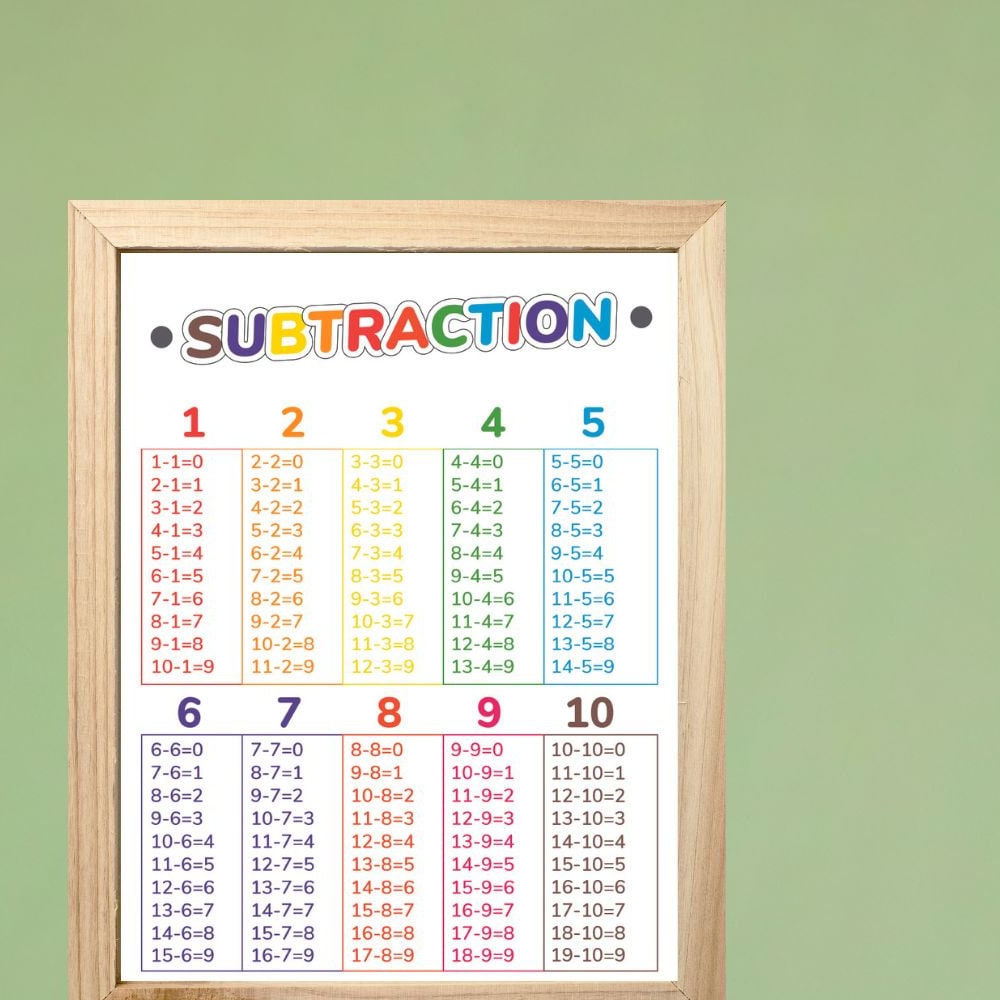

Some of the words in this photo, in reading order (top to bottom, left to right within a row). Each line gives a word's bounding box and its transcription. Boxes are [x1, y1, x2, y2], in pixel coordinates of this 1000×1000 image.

[184, 295, 614, 362] SUBTRACTION
[183, 406, 206, 438] 1
[281, 405, 306, 439] 2
[380, 405, 405, 439] 3
[480, 406, 507, 438] 4
[581, 406, 606, 439] 5
[151, 454, 204, 469] 1-1=0
[251, 453, 304, 470] 2-2=0
[351, 453, 404, 470] 3-3=0
[450, 454, 504, 469] 4-4=0
[551, 453, 604, 470] 5-5=0
[151, 477, 204, 493] 2-1=1
[251, 477, 303, 493] 3-2=1
[451, 477, 504, 493] 5-4=1
[551, 477, 604, 493] 6-5=1
[151, 522, 203, 538] 4-1=3
[251, 522, 303, 538] 5-2=3
[451, 522, 503, 538] 7-4=3
[551, 522, 603, 538] 8-5=3
[151, 545, 204, 561] 5-1=4
[250, 545, 304, 561] 6-2=4
[450, 545, 504, 561] 8-4=4
[551, 545, 604, 561] 9-5=4
[151, 591, 204, 607] 7-1=6
[250, 591, 304, 607] 8-2=6
[452, 591, 515, 607] 10-4=6
[551, 591, 615, 607] 11-5=6
[150, 613, 204, 629] 8-1=7
[250, 613, 304, 630] 9-2=7
[452, 613, 515, 629] 11-4=7
[551, 613, 615, 629] 12-5=7
[152, 659, 215, 674] 10-1=9
[252, 658, 315, 674] 11-2=9
[452, 659, 515, 674] 13-4=9
[552, 658, 615, 674] 14-5=9
[177, 696, 202, 729] 6
[277, 696, 302, 729] 7
[377, 696, 402, 729] 8
[477, 696, 502, 729] 9
[566, 696, 614, 729] 10
[150, 741, 204, 757] 6-6=0
[250, 741, 304, 757] 7-7=0
[350, 741, 404, 757] 8-8=0
[450, 741, 504, 757] 9-9=0
[552, 741, 626, 757] 10-10=0
[151, 765, 203, 780] 7-6=1
[250, 765, 304, 780] 8-7=1
[350, 764, 403, 780] 9-8=1
[451, 765, 515, 780] 10-9=1
[552, 765, 626, 781] 11-10=1
[150, 810, 203, 826] 9-6=3
[252, 810, 315, 826] 10-7=3
[352, 810, 414, 826] 11-8=3
[452, 810, 515, 826] 12-9=3
[551, 810, 625, 826] 13-10=3
[152, 833, 215, 849] 10-6=4
[252, 833, 315, 849] 11-7=4
[352, 833, 415, 849] 12-8=4
[452, 833, 515, 849] 13-9=4
[552, 834, 626, 849] 14-10=4
[152, 879, 215, 895] 12-6=6
[252, 879, 315, 895] 13-7=6
[352, 879, 415, 895] 14-8=6
[452, 879, 515, 895] 15-9=6
[552, 879, 626, 895] 16-10=6
[152, 902, 215, 918] 13-6=7
[252, 902, 315, 918] 14-7=7
[352, 902, 415, 918] 15-8=7
[452, 902, 515, 918] 16-9=7
[552, 902, 626, 918] 17-10=7
[152, 947, 215, 963] 15-6=9
[252, 947, 315, 963] 16-7=9
[352, 947, 415, 963] 17-8=9
[452, 947, 515, 963] 18-9=9
[552, 947, 626, 963] 19-10=9
